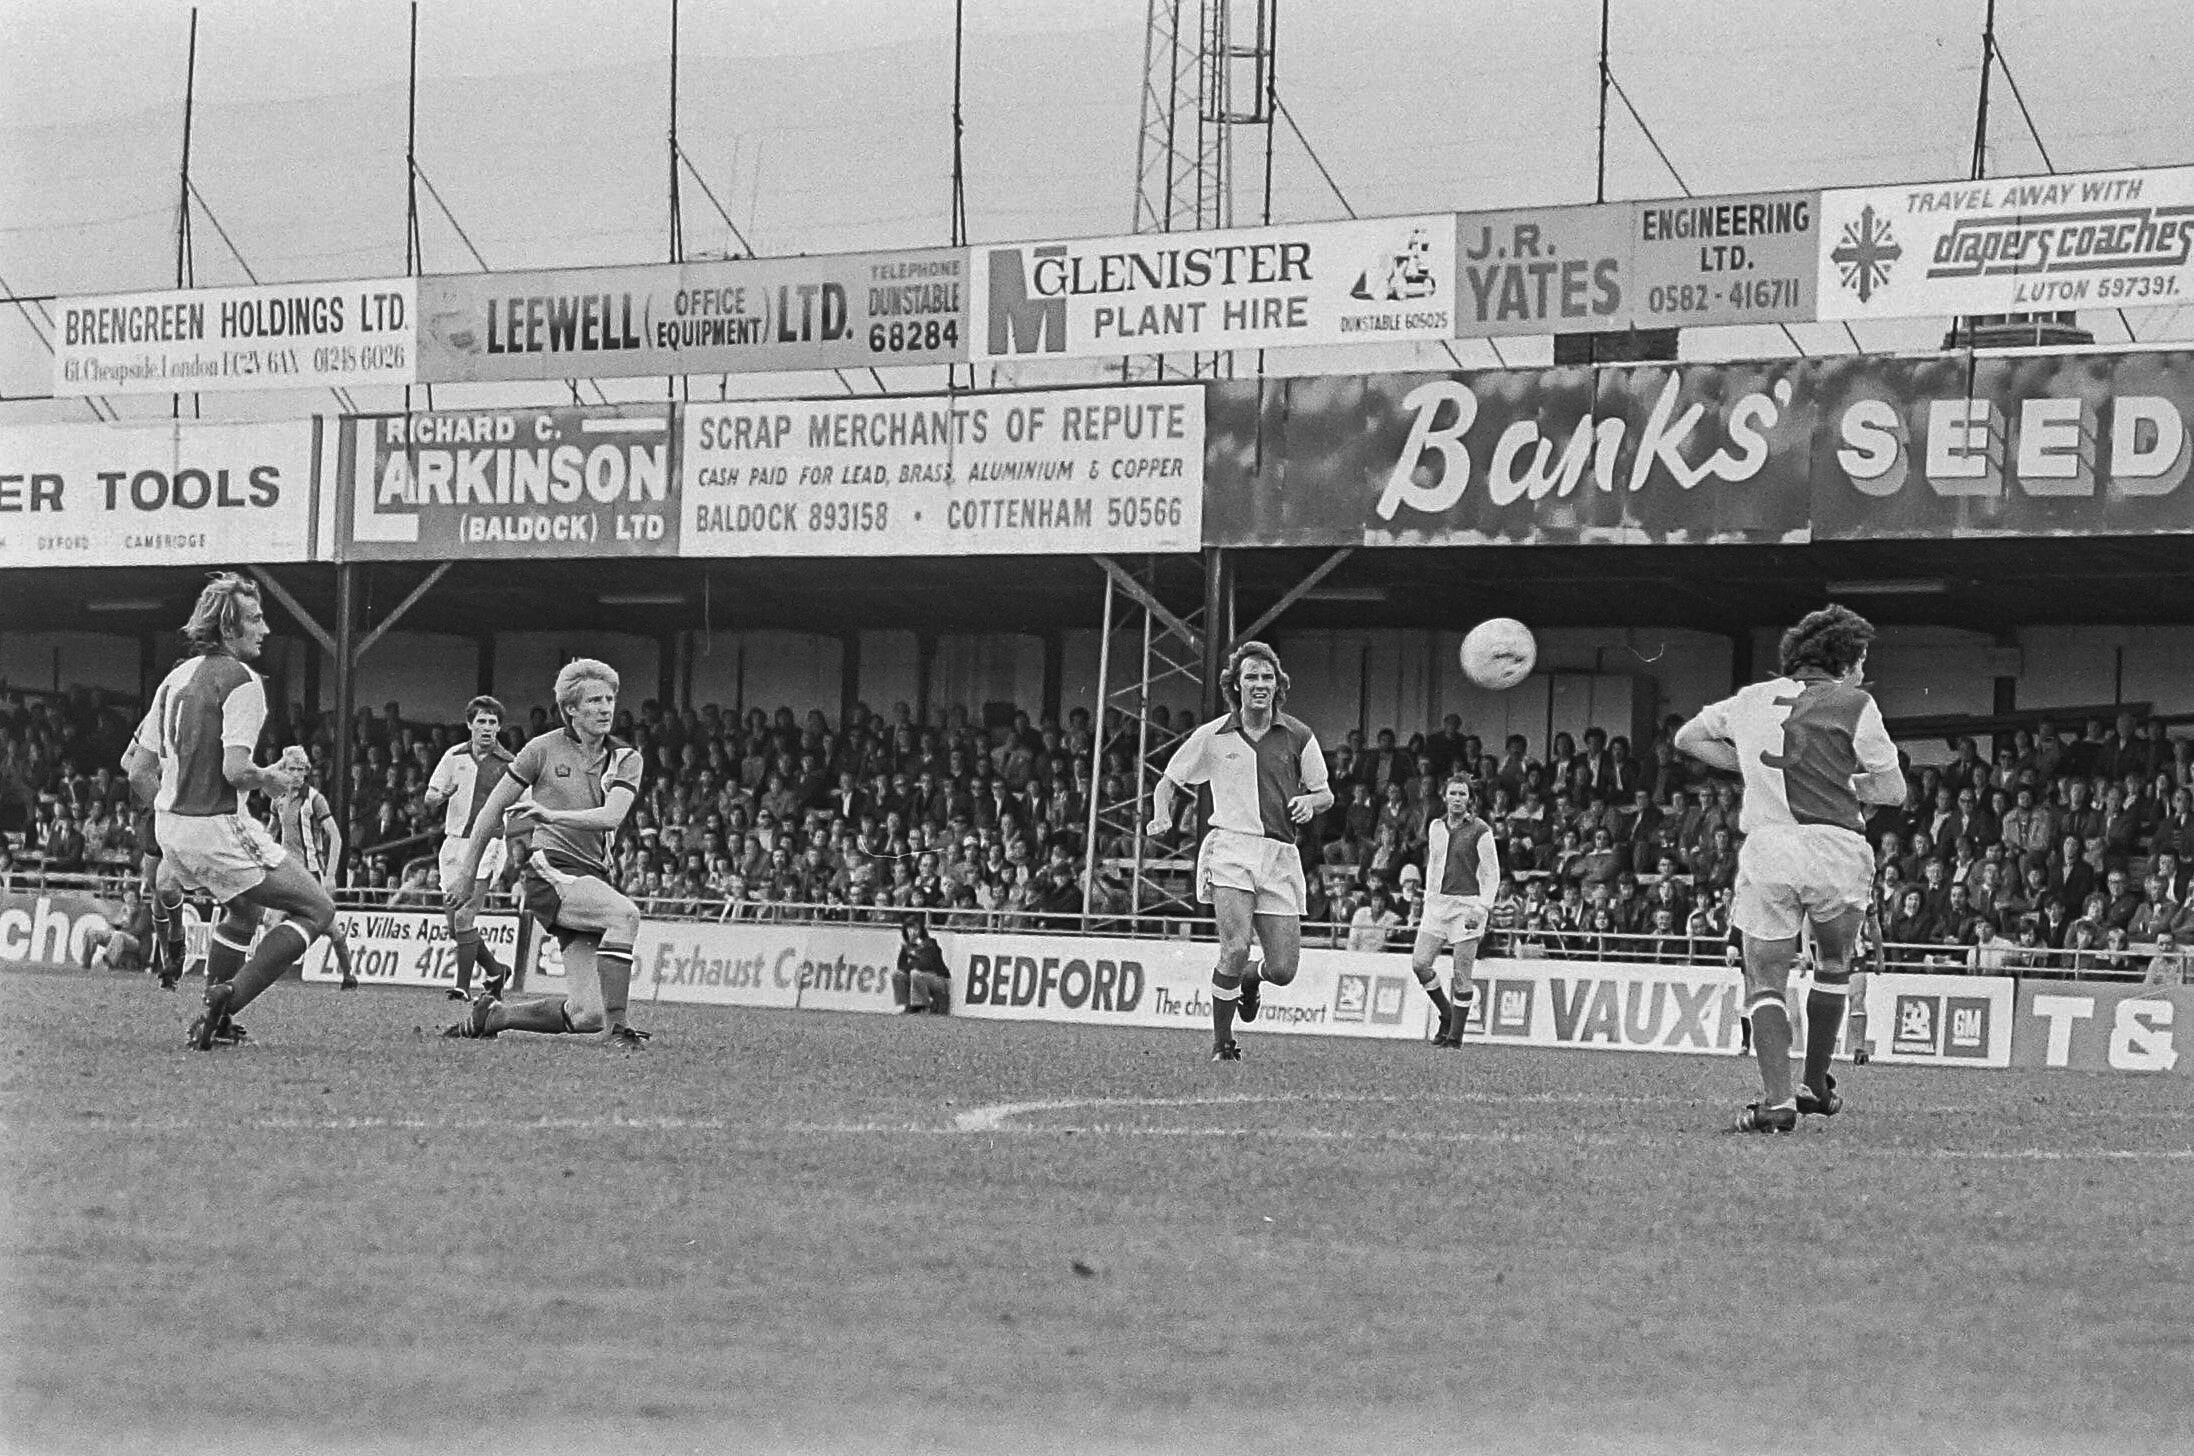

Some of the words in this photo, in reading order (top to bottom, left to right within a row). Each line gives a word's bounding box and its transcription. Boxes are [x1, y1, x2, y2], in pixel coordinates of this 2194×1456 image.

[1907, 190, 1994, 213] TRAVEL
[2000, 183, 2074, 209] AWAY
[2081, 179, 2144, 203] WITH
[1642, 201, 1810, 241] ENGINEERING
[1466, 223, 1556, 260] J.R.
[1700, 245, 1754, 272] LTD.
[872, 260, 960, 281] TELEPHONE
[1033, 241, 1313, 297] GLENISTER
[868, 282, 960, 317] DUNSTABLE
[1465, 258, 1622, 322] YATES
[2015, 279, 2089, 302] LUTON
[66, 303, 205, 345] BRENGREEN
[221, 296, 344, 338] HOLDINGS
[487, 291, 640, 353] LEEWELL
[777, 282, 853, 343] LTD.
[868, 319, 959, 352] 68284
[1095, 302, 1207, 338] PLANT
[1223, 297, 1308, 330] HIRE
[386, 415, 515, 444] RICHARD
[535, 415, 561, 440] C.
[700, 415, 792, 449] SCRAP
[808, 409, 988, 448] MERCHANTS
[1006, 407, 1045, 442] OF
[1062, 404, 1184, 441] REPUTE
[1837, 396, 2190, 490] SEED
[97, 466, 281, 511] TOOLS
[699, 467, 740, 486] CASH
[749, 466, 788, 486] PAID
[799, 465, 833, 485] FOR
[968, 460, 1074, 482] ALUMINIUM
[1112, 458, 1183, 479] COPPER
[460, 513, 597, 543] (BALDOCK)
[616, 514, 664, 540] LTD
[696, 502, 798, 532] BALDOCK
[808, 501, 888, 531] 893158
[948, 498, 1092, 529] COTTENHAM
[1108, 496, 1182, 527] 50566
[125, 533, 206, 549] CAMBRIDGE
[652, 943, 765, 988] Exhaust
[773, 947, 889, 994] Centres
[965, 954, 1145, 1012] BEDFORD
[1155, 987, 1182, 1015] The
